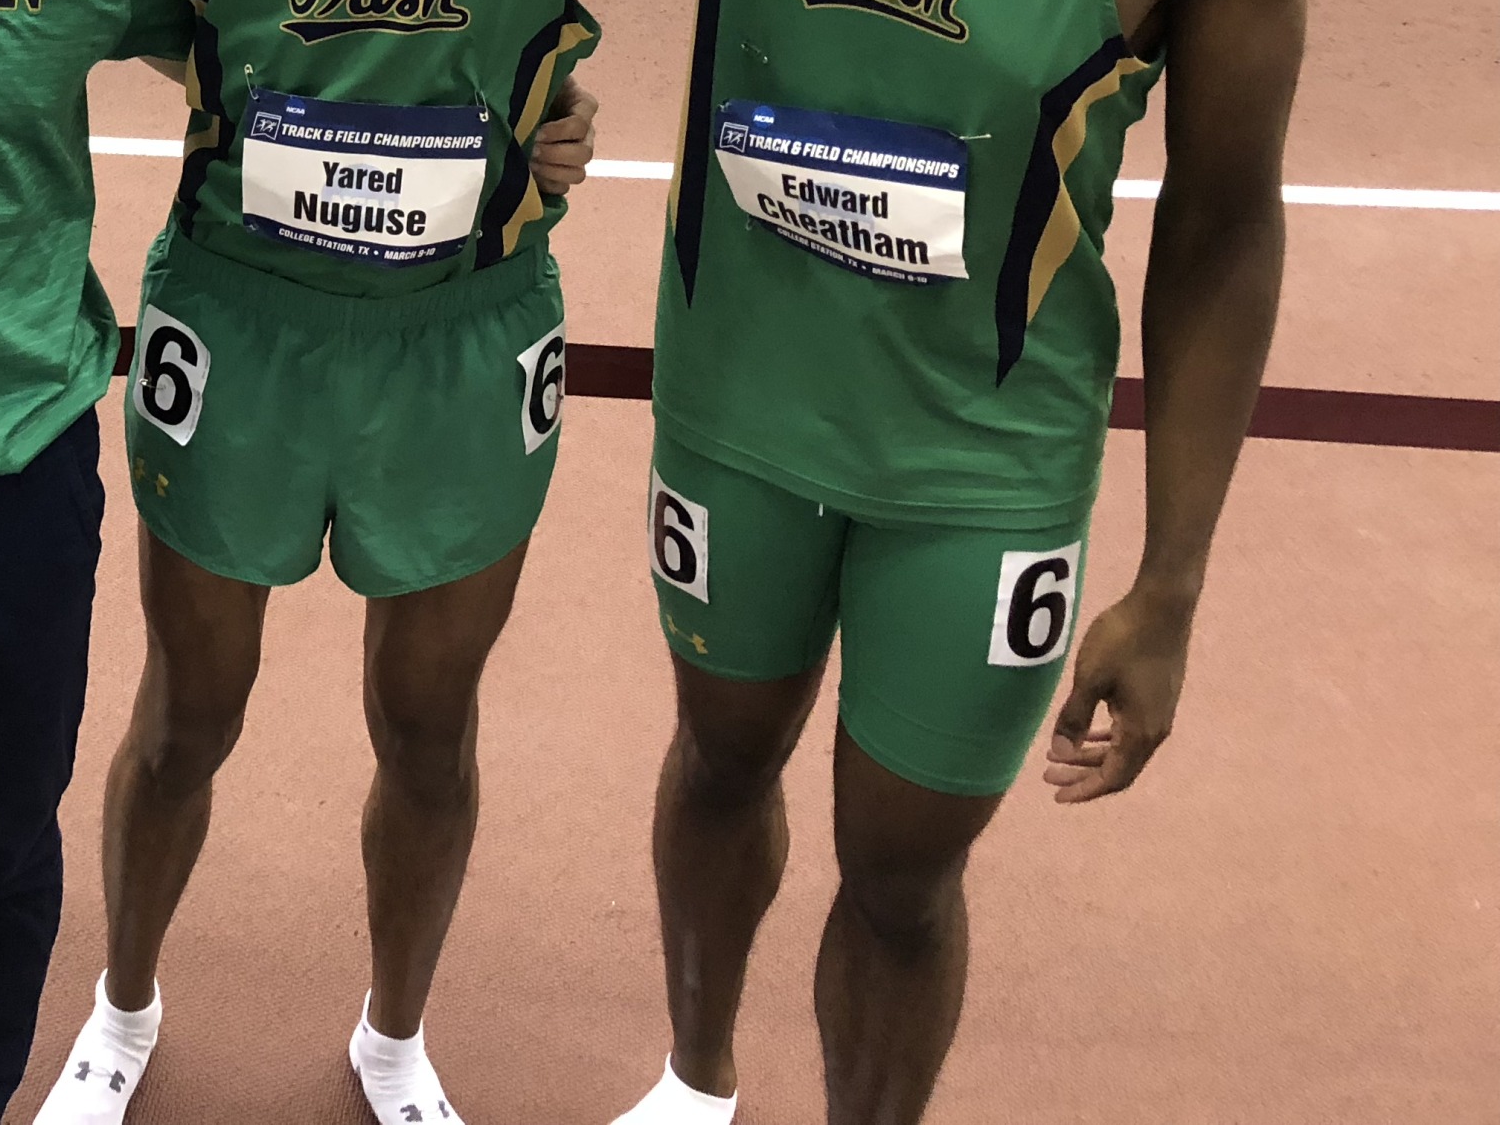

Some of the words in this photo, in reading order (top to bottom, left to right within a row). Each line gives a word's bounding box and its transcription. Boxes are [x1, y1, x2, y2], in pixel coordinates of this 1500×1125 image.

[286, 106, 306, 116] NCAA
[281, 123, 323, 141] TRACK
[323, 129, 334, 142] &
[335, 130, 372, 145] FIELD
[373, 132, 484, 150] CHAMPIONSHIPS
[749, 134, 792, 155] TRACK
[790, 140, 802, 156] &
[802, 142, 841, 162] FIELD
[842, 148, 960, 179] CHAMPIONSHIPS
[322, 161, 403, 194] Yared
[781, 173, 889, 219] Edward
[293, 190, 427, 236] Nuguse
[757, 192, 930, 265] Cheatham
[278, 227, 315, 244] COLLEGE
[315, 237, 355, 254] STATION,
[358, 245, 370, 255] TX
[384, 249, 417, 260] MARCH
[417, 246, 437, 259] 9-10
[142, 325, 198, 426] 6
[529, 335, 565, 435] 6
[654, 490, 697, 585] 6
[1007, 557, 1070, 659] 6
